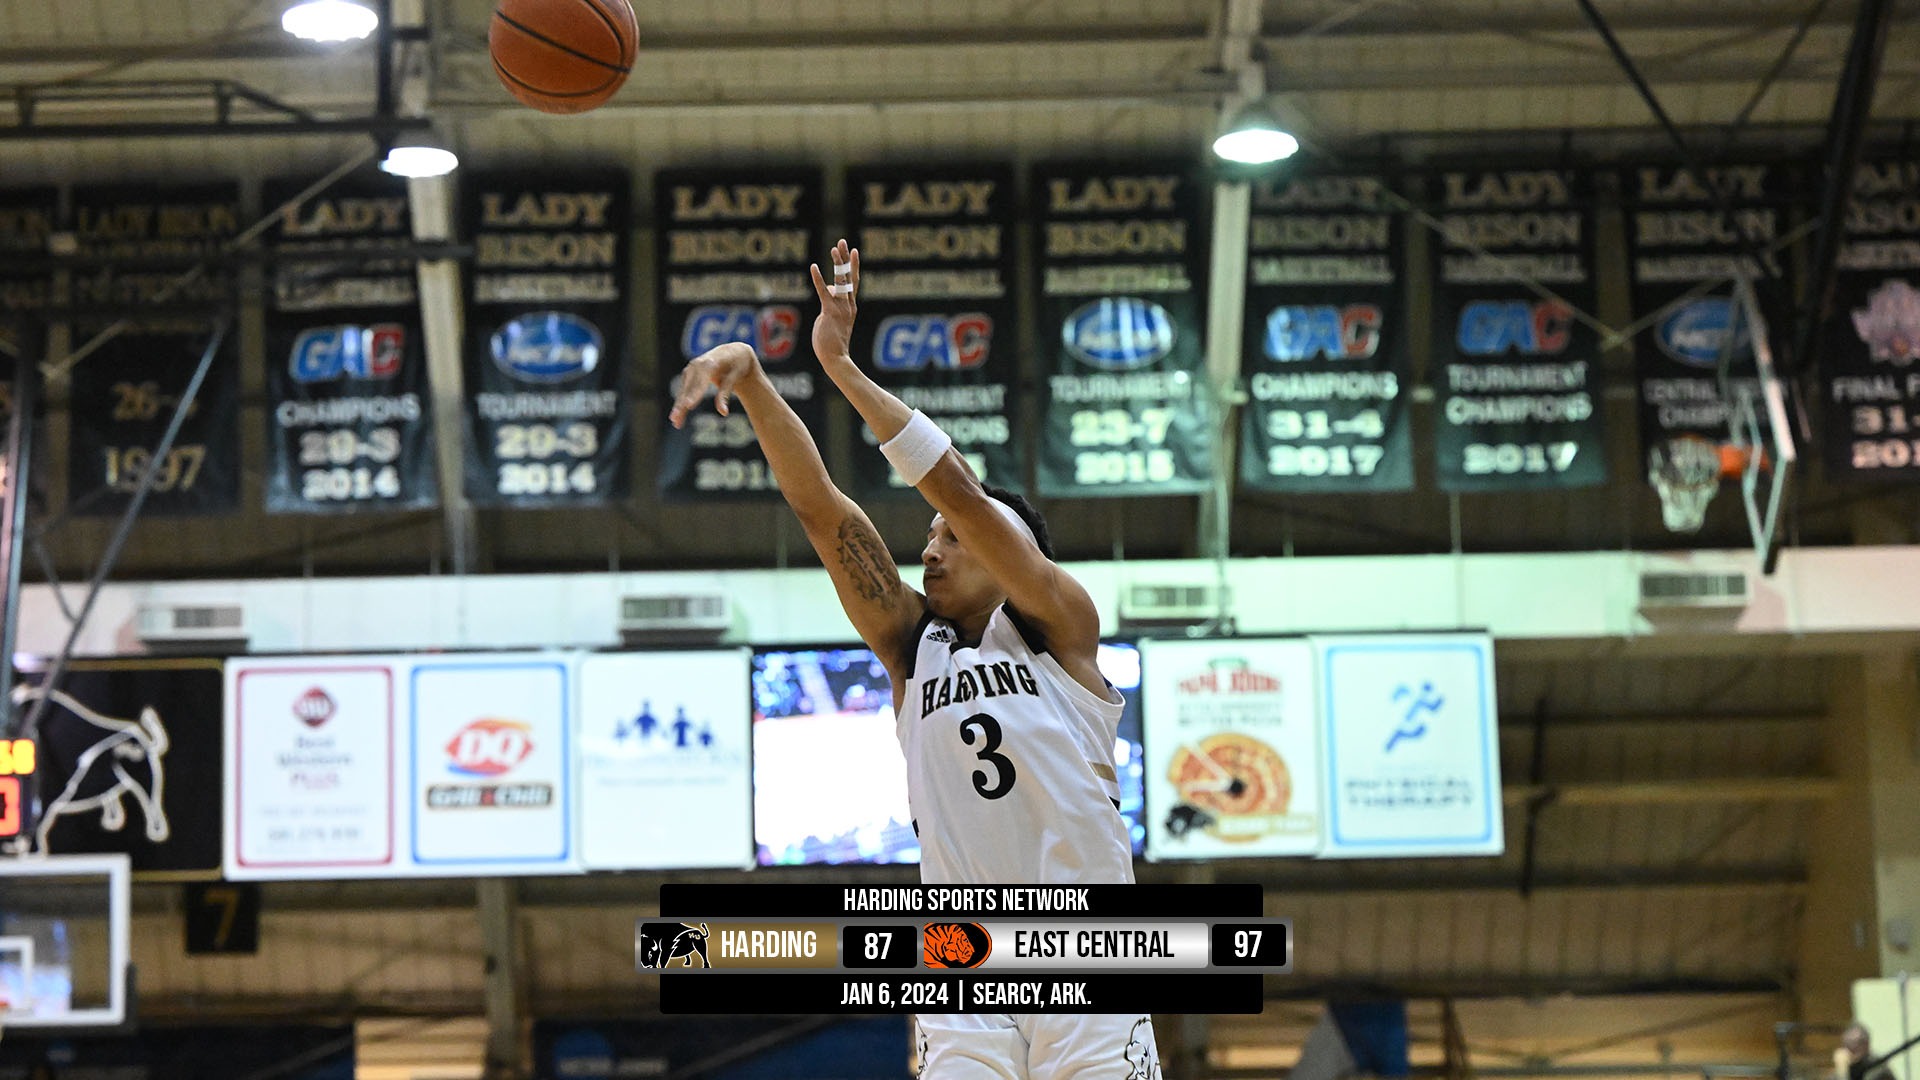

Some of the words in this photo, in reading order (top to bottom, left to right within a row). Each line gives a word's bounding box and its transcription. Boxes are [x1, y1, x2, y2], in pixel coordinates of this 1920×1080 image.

[482, 193, 611, 225] LADY
[673, 185, 800, 221] LADY
[864, 182, 993, 216] LADY
[1050, 177, 1177, 212] LADY
[476, 233, 616, 267] BISON
[670, 230, 807, 264] BISON
[861, 225, 1001, 261] BISON
[1047, 220, 1186, 256] BISON
[1252, 216, 1388, 250] BISON
[873, 313, 993, 371] GAC
[1252, 371, 1398, 401] CHAMPIONS
[1448, 361, 1588, 391] TOURNAMENT
[1446, 393, 1593, 425] CHAMPIONS
[1070, 408, 1175, 447] 23-7
[1267, 444, 1384, 477] 2017
[1462, 441, 1579, 475] 2017
[301, 465, 400, 500] 2014
[498, 462, 597, 494] 2014
[921, 661, 1040, 720] HARDING
[459, 730, 524, 762] DQ
[959, 712, 1016, 800] 3
[205, 889, 238, 948] 7
